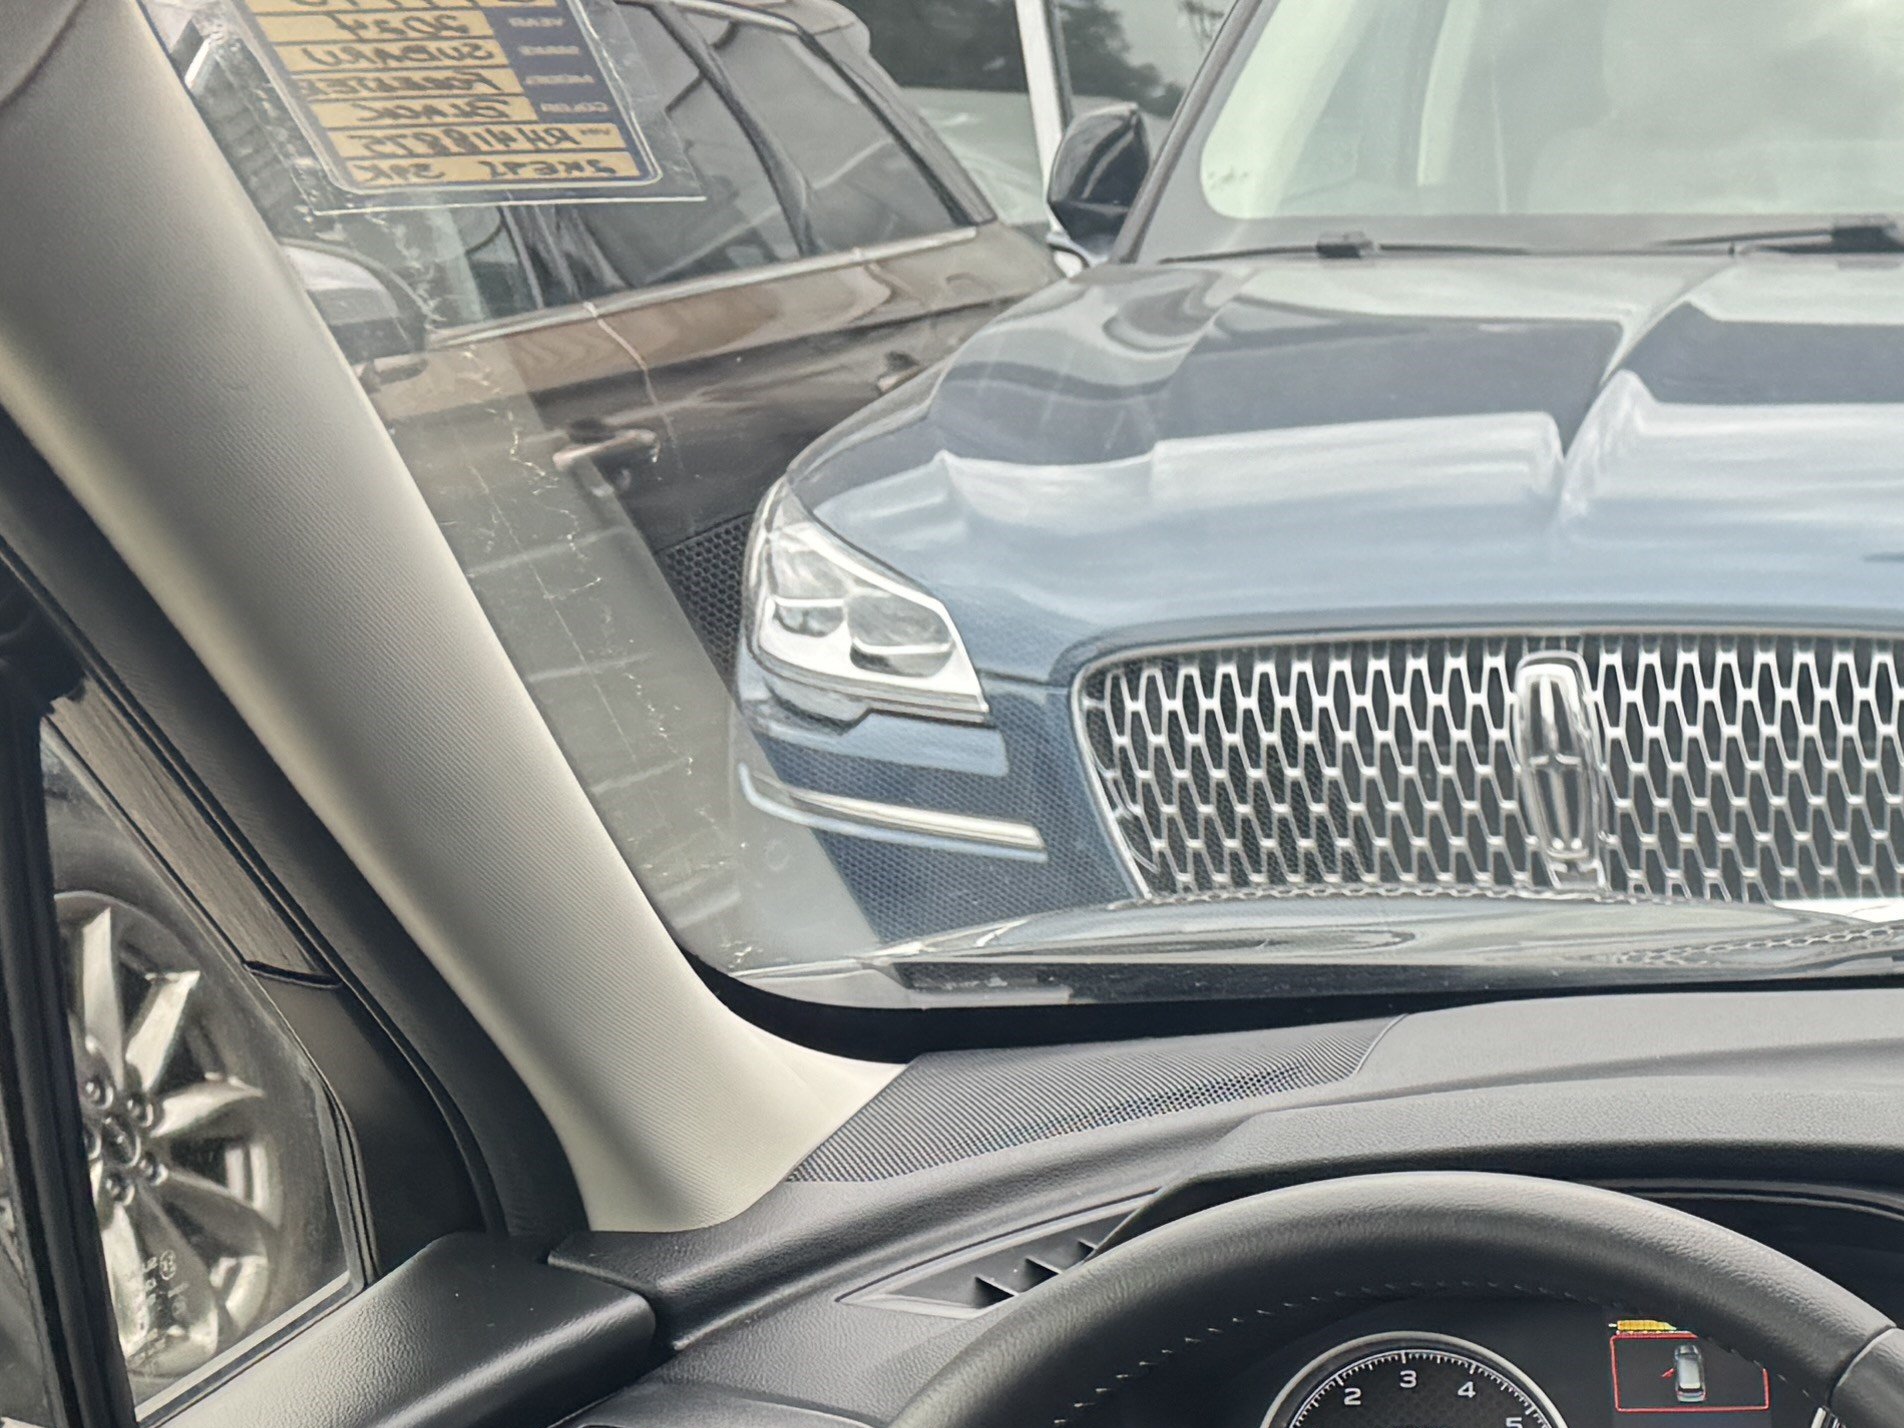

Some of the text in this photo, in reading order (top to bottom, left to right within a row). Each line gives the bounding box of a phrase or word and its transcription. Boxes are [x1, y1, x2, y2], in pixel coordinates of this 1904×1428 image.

[1399, 1369, 1418, 1389] 3
[1344, 1387, 1362, 1406] 2
[1457, 1381, 1476, 1399] 4
